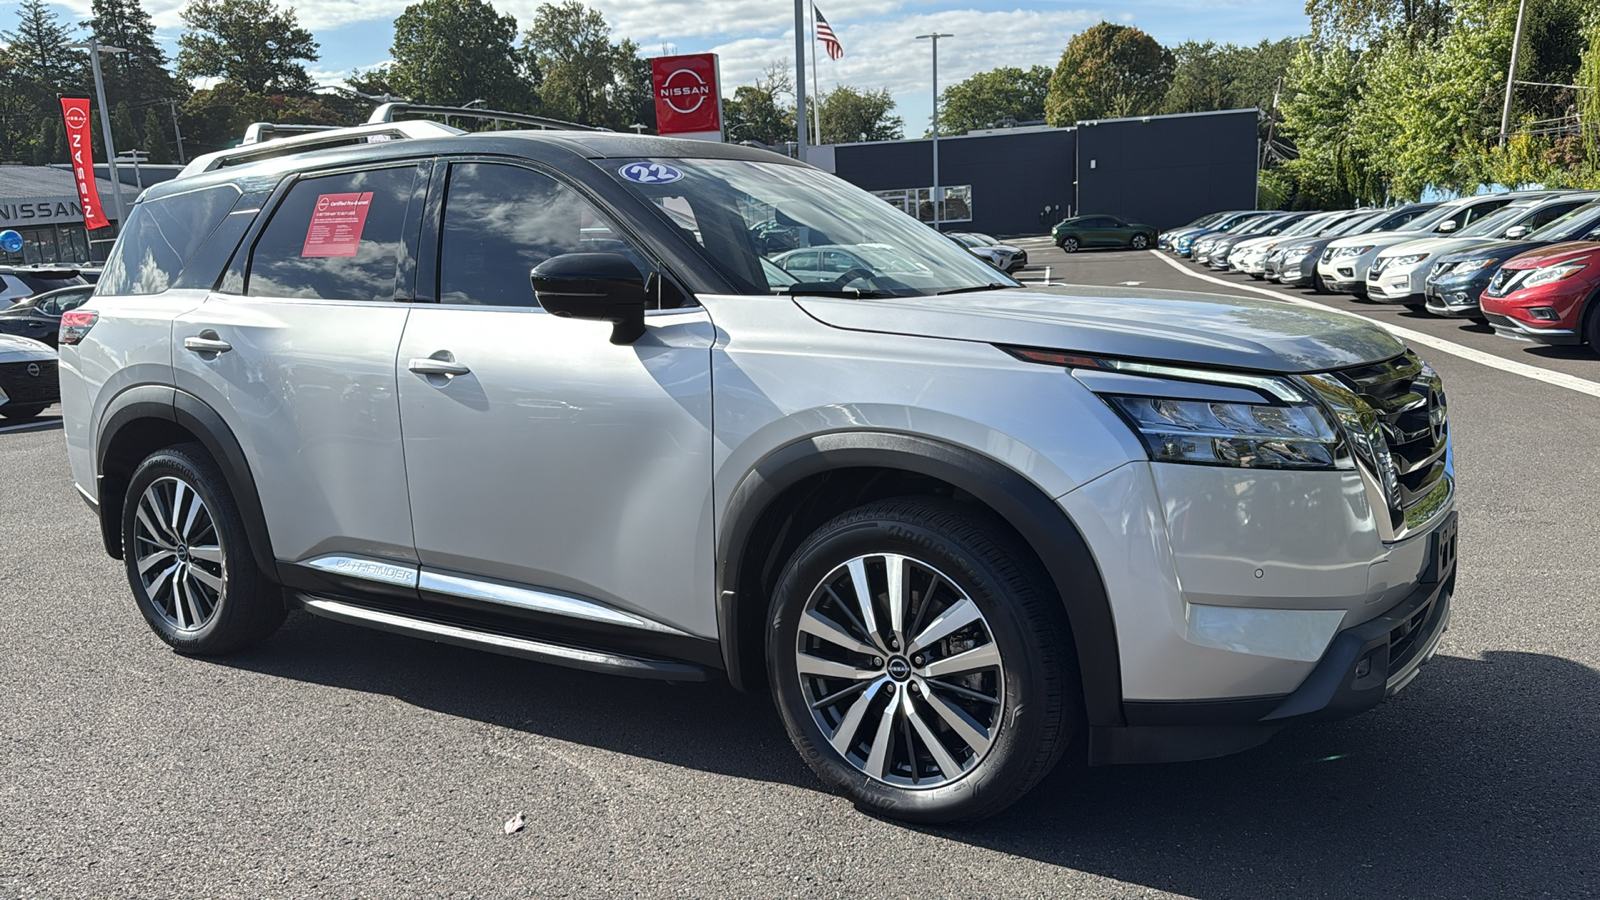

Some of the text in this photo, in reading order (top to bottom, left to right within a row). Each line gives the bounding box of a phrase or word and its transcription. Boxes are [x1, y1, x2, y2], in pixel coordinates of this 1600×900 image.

[660, 86, 709, 97] NISSAN
[72, 134, 95, 219] NISSAN
[630, 163, 676, 181] 22
[0, 201, 83, 220] NISSAN
[148, 459, 199, 486] BRIDGESTONE
[336, 559, 413, 580] PATHFINDER
